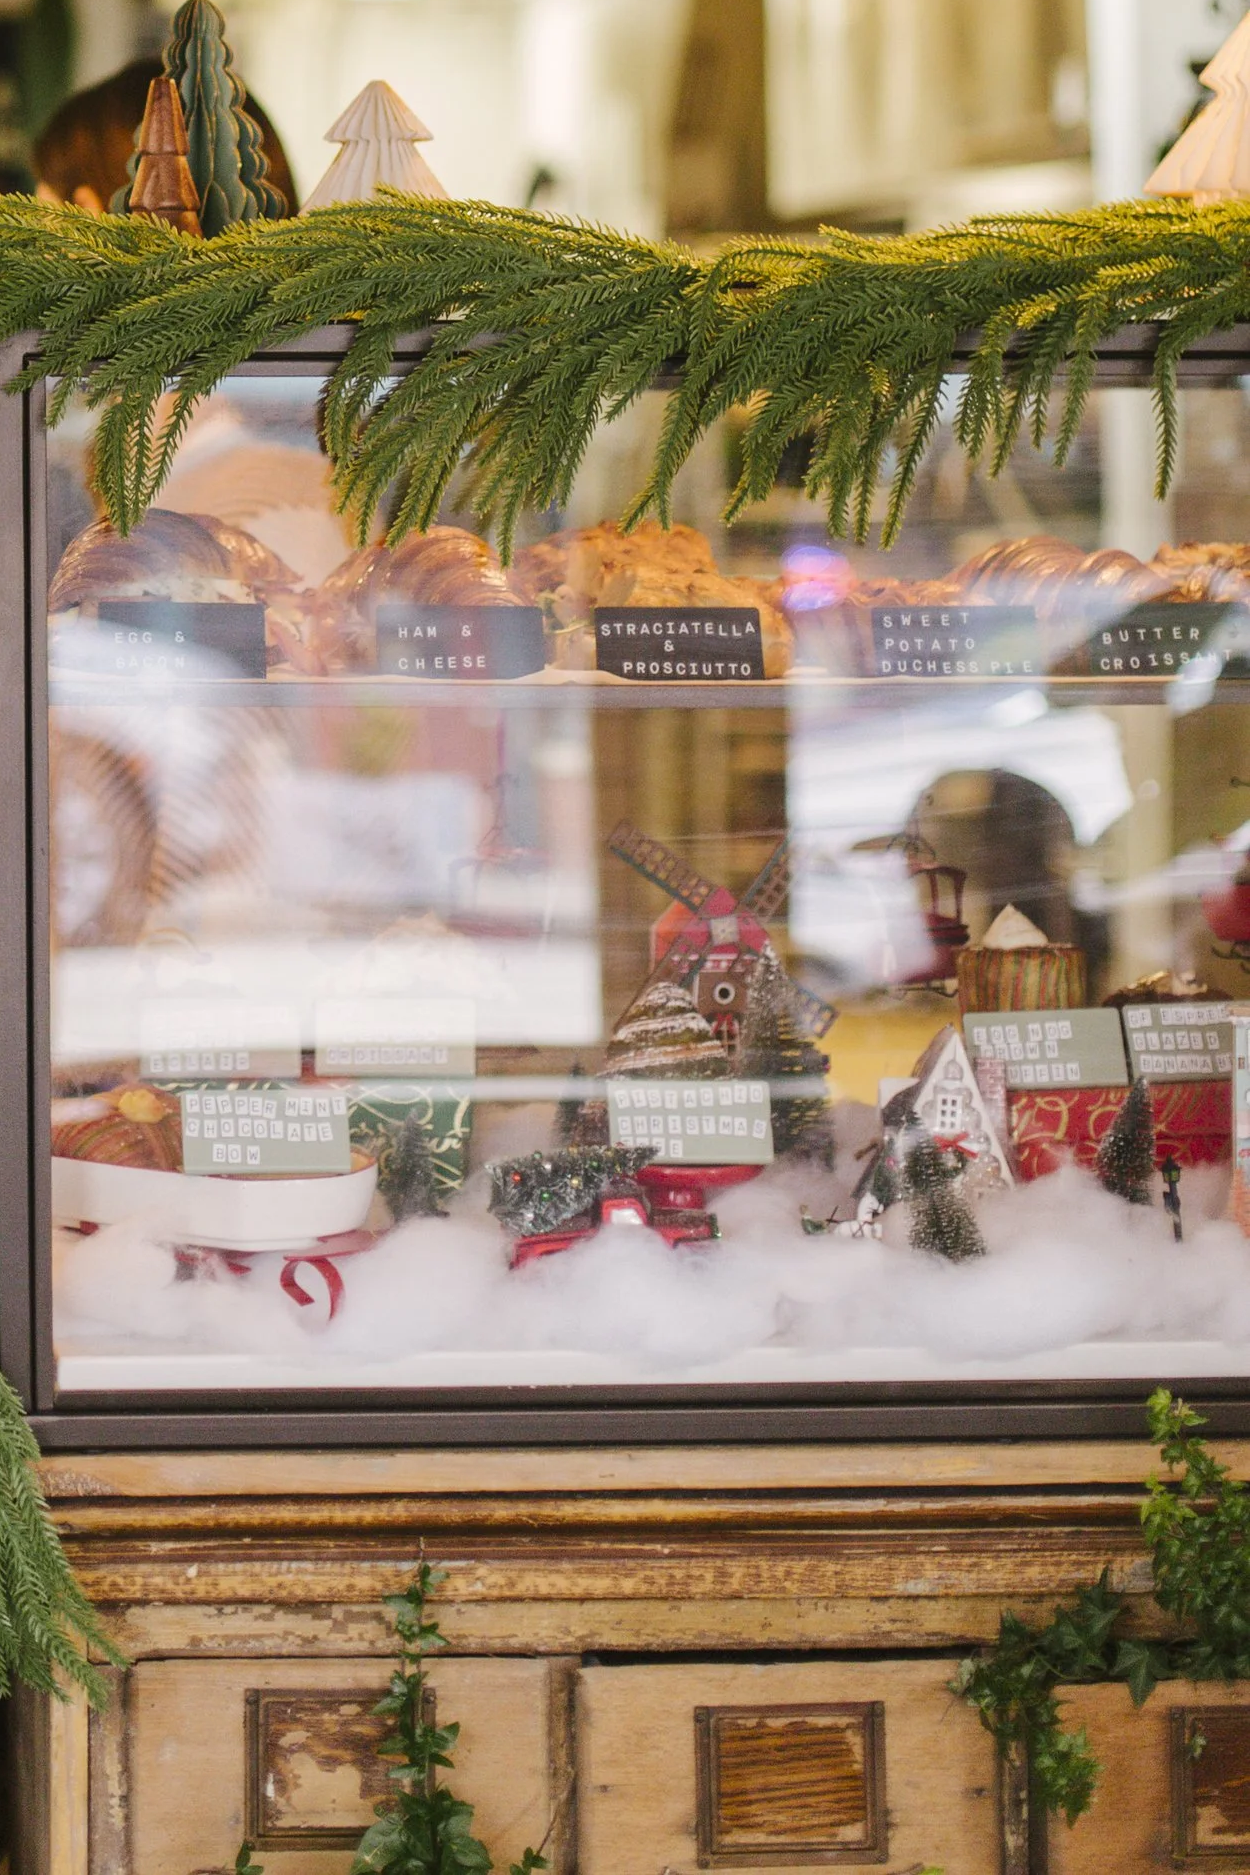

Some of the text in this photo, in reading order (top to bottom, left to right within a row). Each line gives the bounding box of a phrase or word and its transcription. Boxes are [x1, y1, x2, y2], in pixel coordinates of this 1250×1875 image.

[882, 611, 970, 629] SWEET
[114, 630, 186, 644] EGG &
[397, 624, 473, 639] HAM &
[600, 621, 756, 637] STRACIATELLA
[1101, 626, 1201, 646] BUTTER
[663, 639, 676, 653] &
[884, 637, 976, 653] POTATO
[398, 654, 487, 671] CHEESE
[622, 660, 752, 676] PROSCIUTTO
[881, 658, 1034, 675] DUCHESS PIE
[975, 1026, 1017, 1043] EGG
[1135, 1033, 1218, 1048] GLAZED
[151, 1053, 249, 1072] ECLAIR
[1141, 1056, 1211, 1071] BANANA
[1008, 1064, 1080, 1080] UFFIN
[617, 1086, 763, 1108] PISTACHIO
[186, 1119, 333, 1140] CHOCOLATE
[619, 1117, 766, 1137] CHRISTMAS
[214, 1145, 260, 1163] BOW
